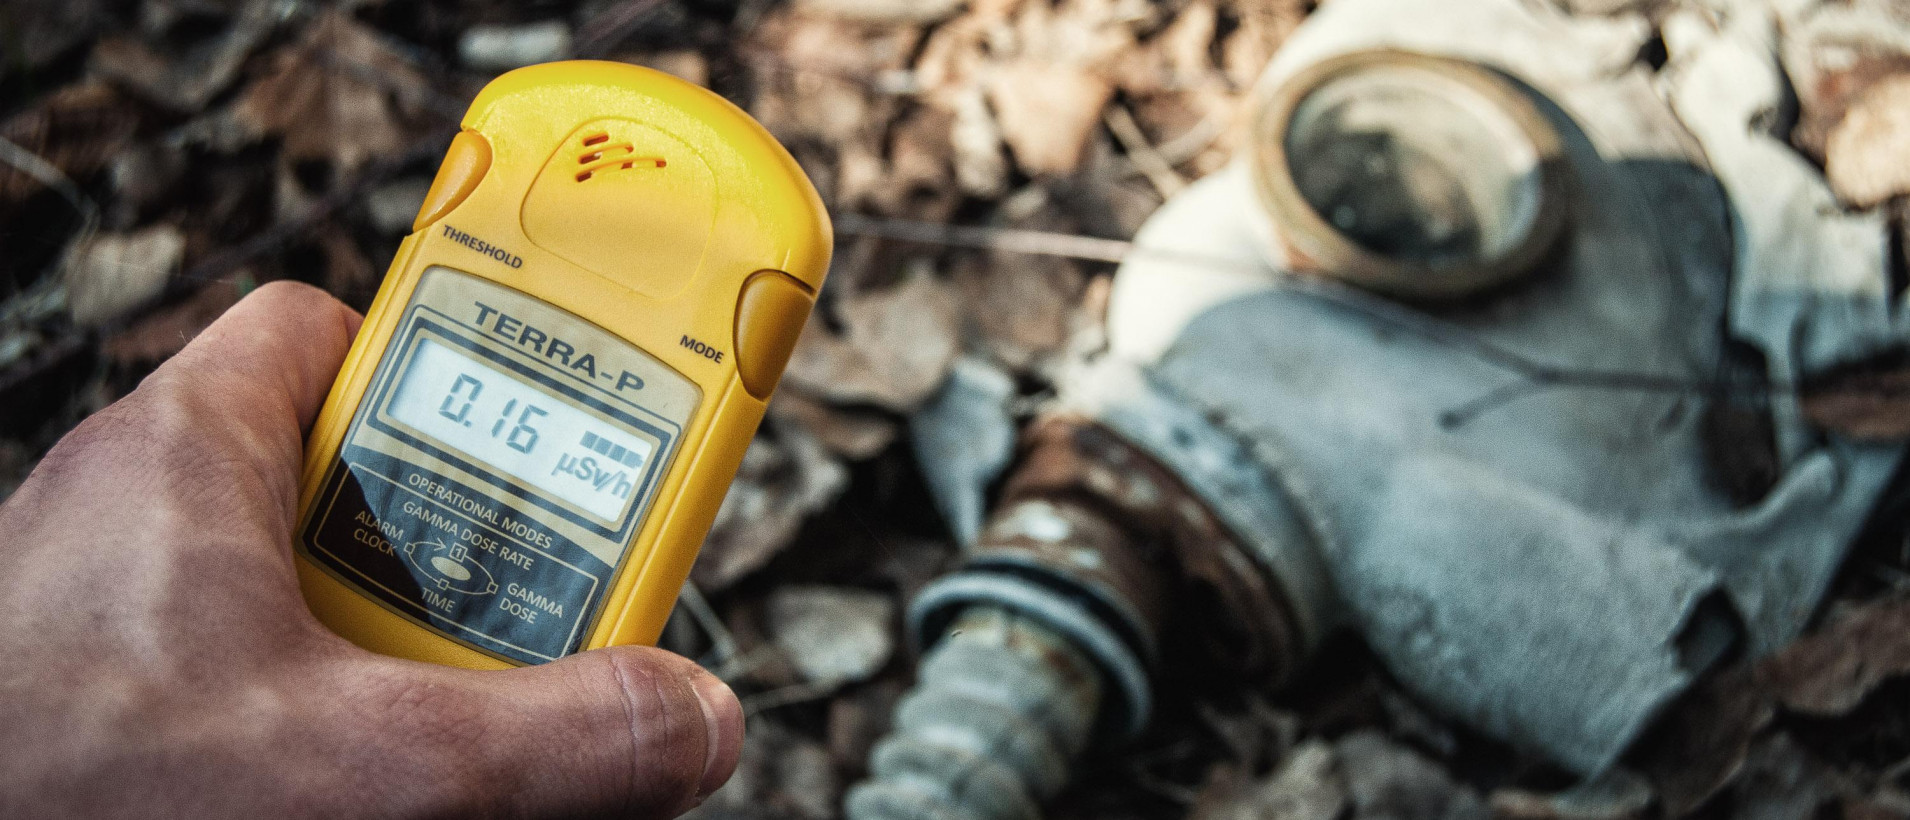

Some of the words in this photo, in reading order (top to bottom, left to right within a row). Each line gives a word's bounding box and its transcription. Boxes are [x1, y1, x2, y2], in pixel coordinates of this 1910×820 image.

[442, 225, 523, 269] THRESHOLD
[473, 301, 645, 393] TERRA-P
[680, 334, 725, 364] MODE
[438, 373, 549, 454] 0.16
[354, 510, 404, 541] ALARM
[408, 473, 498, 526] OPERATIONAL
[501, 516, 553, 549] MODES
[354, 528, 397, 557] CLOCK
[403, 501, 458, 536] GAMMA
[460, 528, 498, 555] DOSE
[499, 545, 534, 571] RATE
[422, 587, 456, 613] TIME
[500, 597, 538, 625] DOSE
[507, 582, 564, 619] GAMMA
